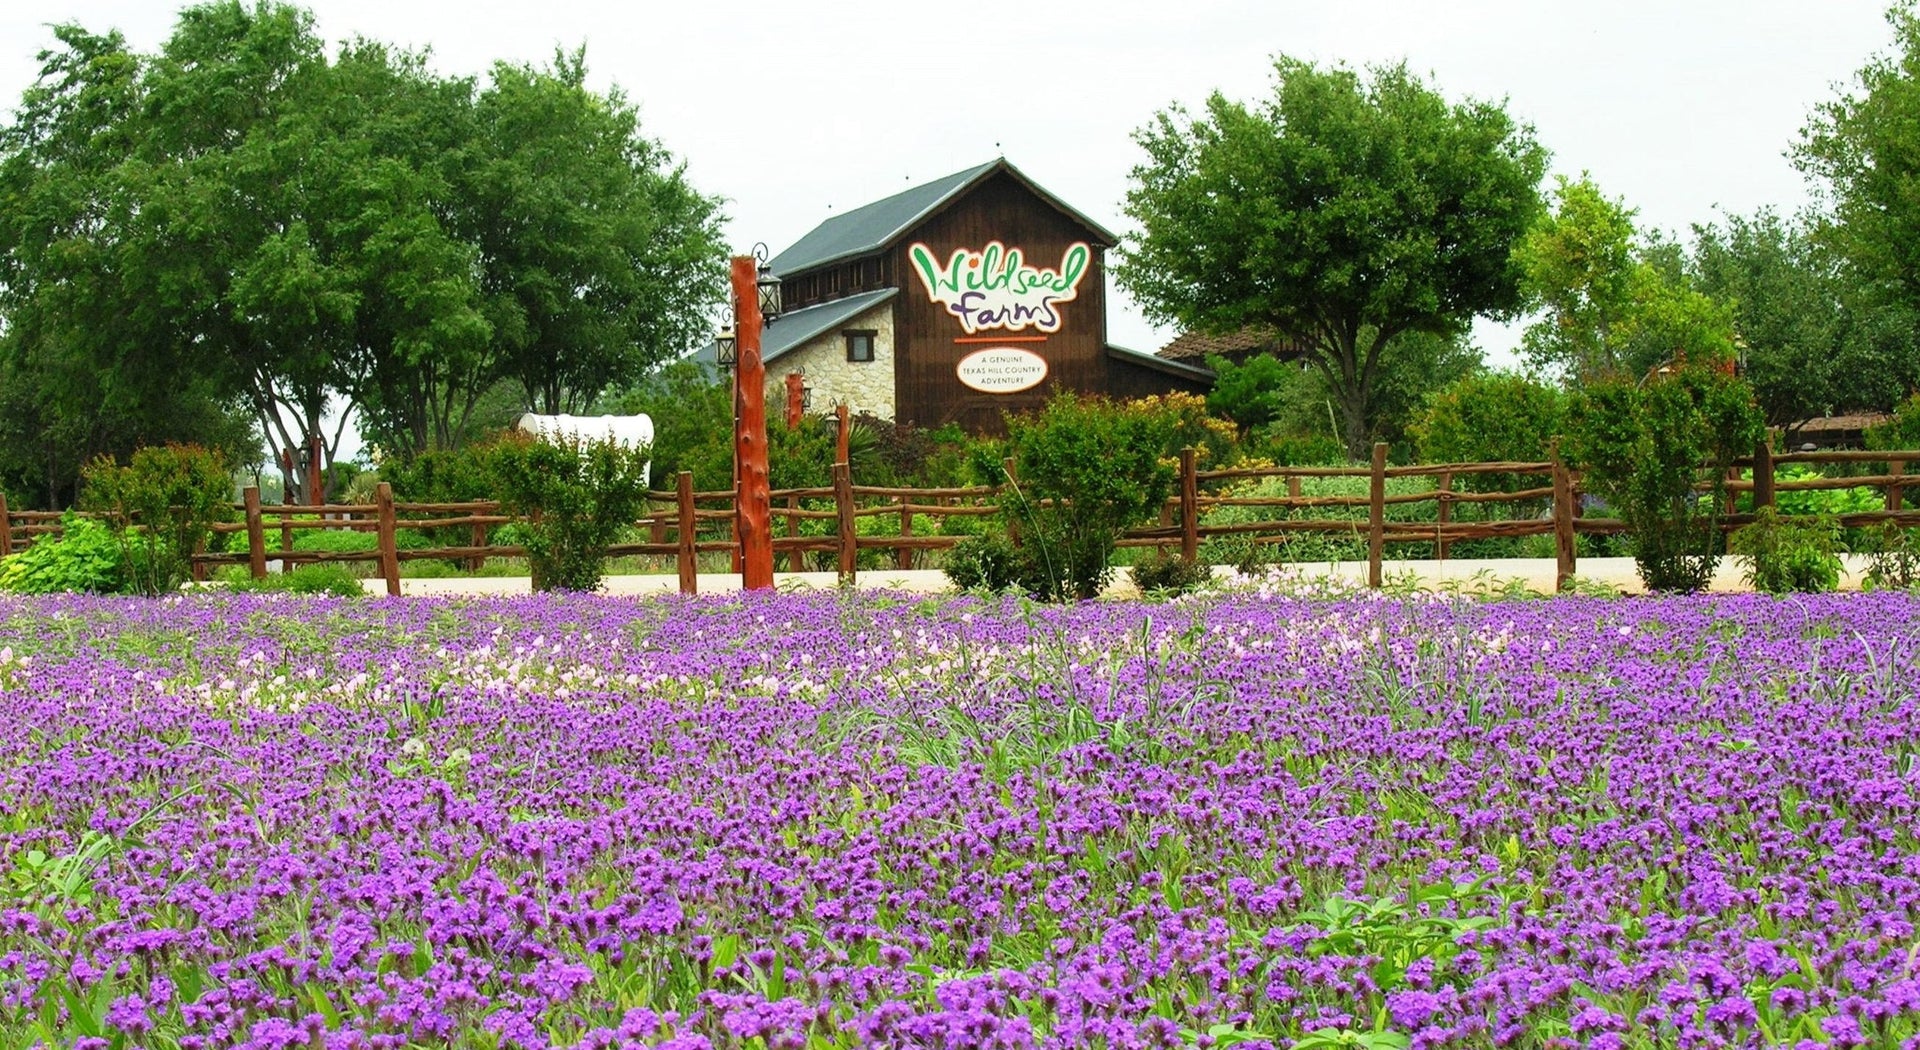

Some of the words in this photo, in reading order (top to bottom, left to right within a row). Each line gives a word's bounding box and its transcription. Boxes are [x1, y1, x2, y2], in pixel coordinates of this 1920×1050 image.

[914, 245, 1086, 295] Wildseed
[951, 291, 1061, 329] Farms
[1004, 366, 1041, 374] COUNTRY
